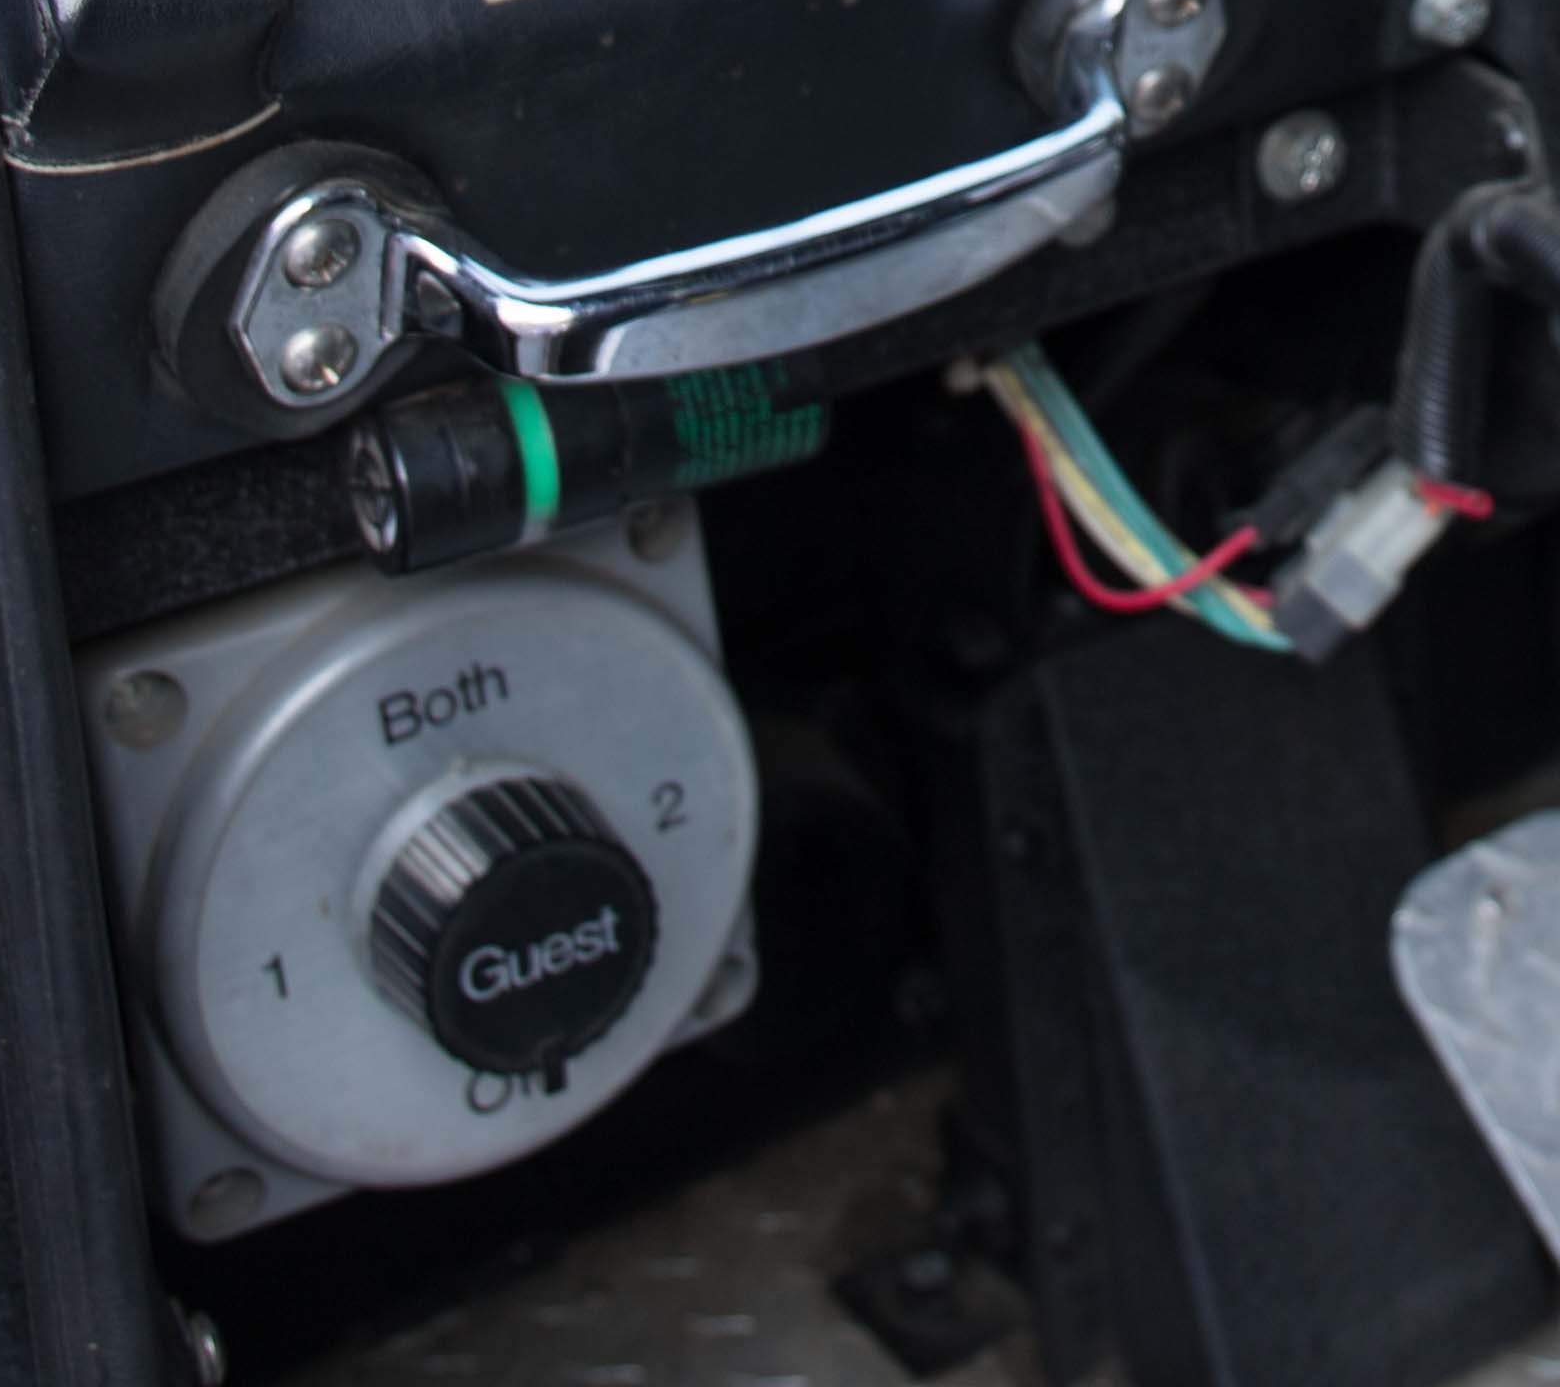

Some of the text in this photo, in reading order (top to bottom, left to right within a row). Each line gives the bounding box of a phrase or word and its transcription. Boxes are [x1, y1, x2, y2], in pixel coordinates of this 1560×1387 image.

[378, 662, 510, 745] Both
[650, 780, 688, 833] 2
[262, 951, 290, 1000] 1
[459, 904, 622, 1003] Guest
